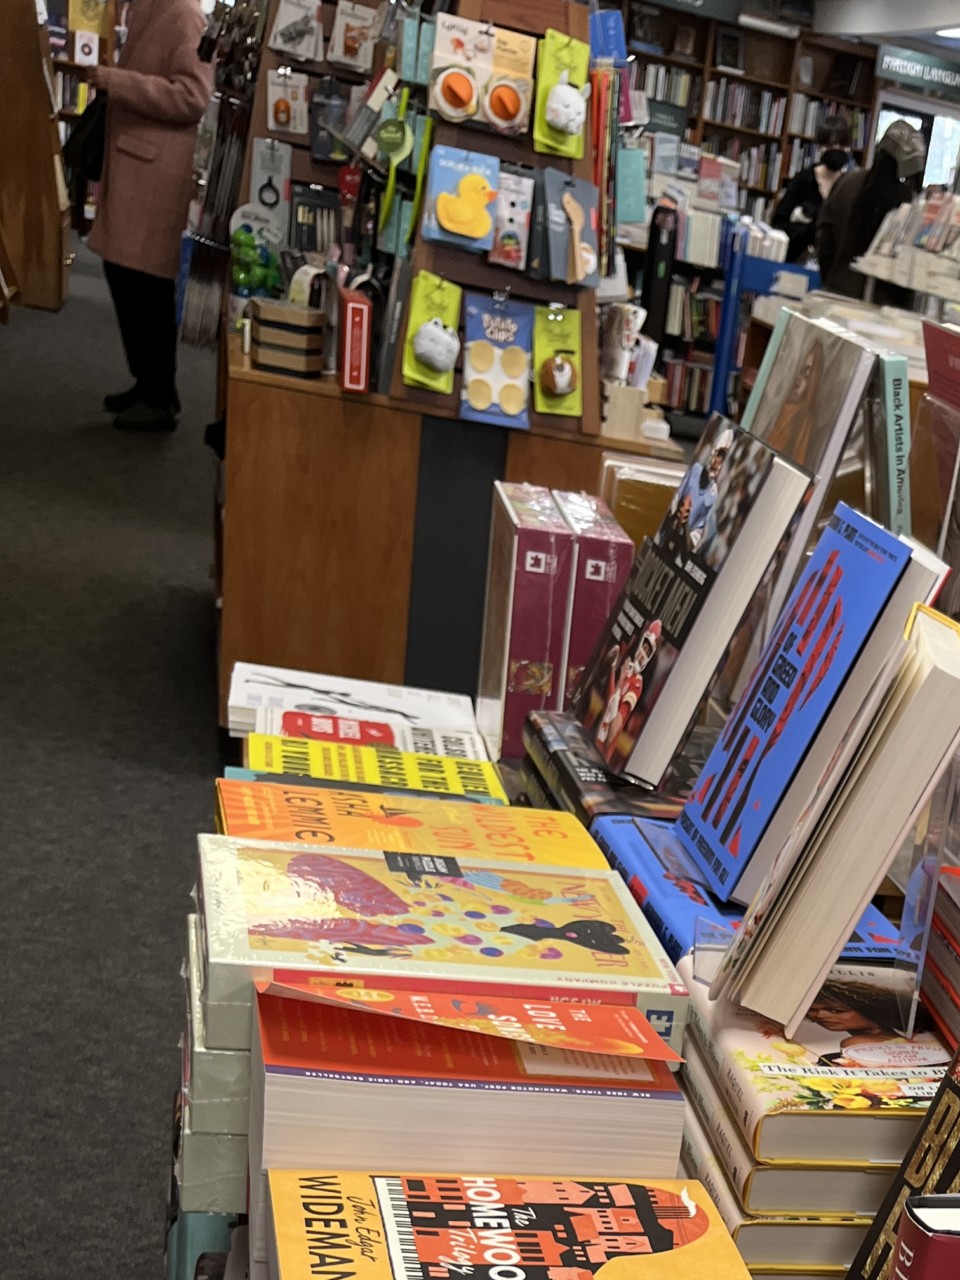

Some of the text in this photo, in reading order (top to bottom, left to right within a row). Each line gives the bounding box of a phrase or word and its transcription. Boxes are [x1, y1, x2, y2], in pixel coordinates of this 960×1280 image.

[892, 378, 902, 412] Black
[894, 414, 904, 452] Artists
[772, 662, 798, 689] GREED
[750, 701, 777, 734] GLORY
[416, 758, 450, 791] FOR THE
[283, 791, 335, 843] LEMMIE
[331, 792, 368, 819] ASHA
[433, 826, 475, 850] SUN
[470, 806, 535, 861] WILDEST
[523, 816, 559, 837] THE
[523, 1003, 567, 1032] LOVE
[728, 1068, 744, 1102] RAQUEL
[763, 1065, 797, 1075] The
[802, 1066, 839, 1076] Risk
[844, 1067, 860, 1077] It
[864, 1068, 908, 1077] Takes
[911, 1068, 928, 1077] to
[347, 1195, 376, 1262] John Edgar
[512, 1208, 537, 1227] The
[439, 1220, 476, 1276] Trilogy
